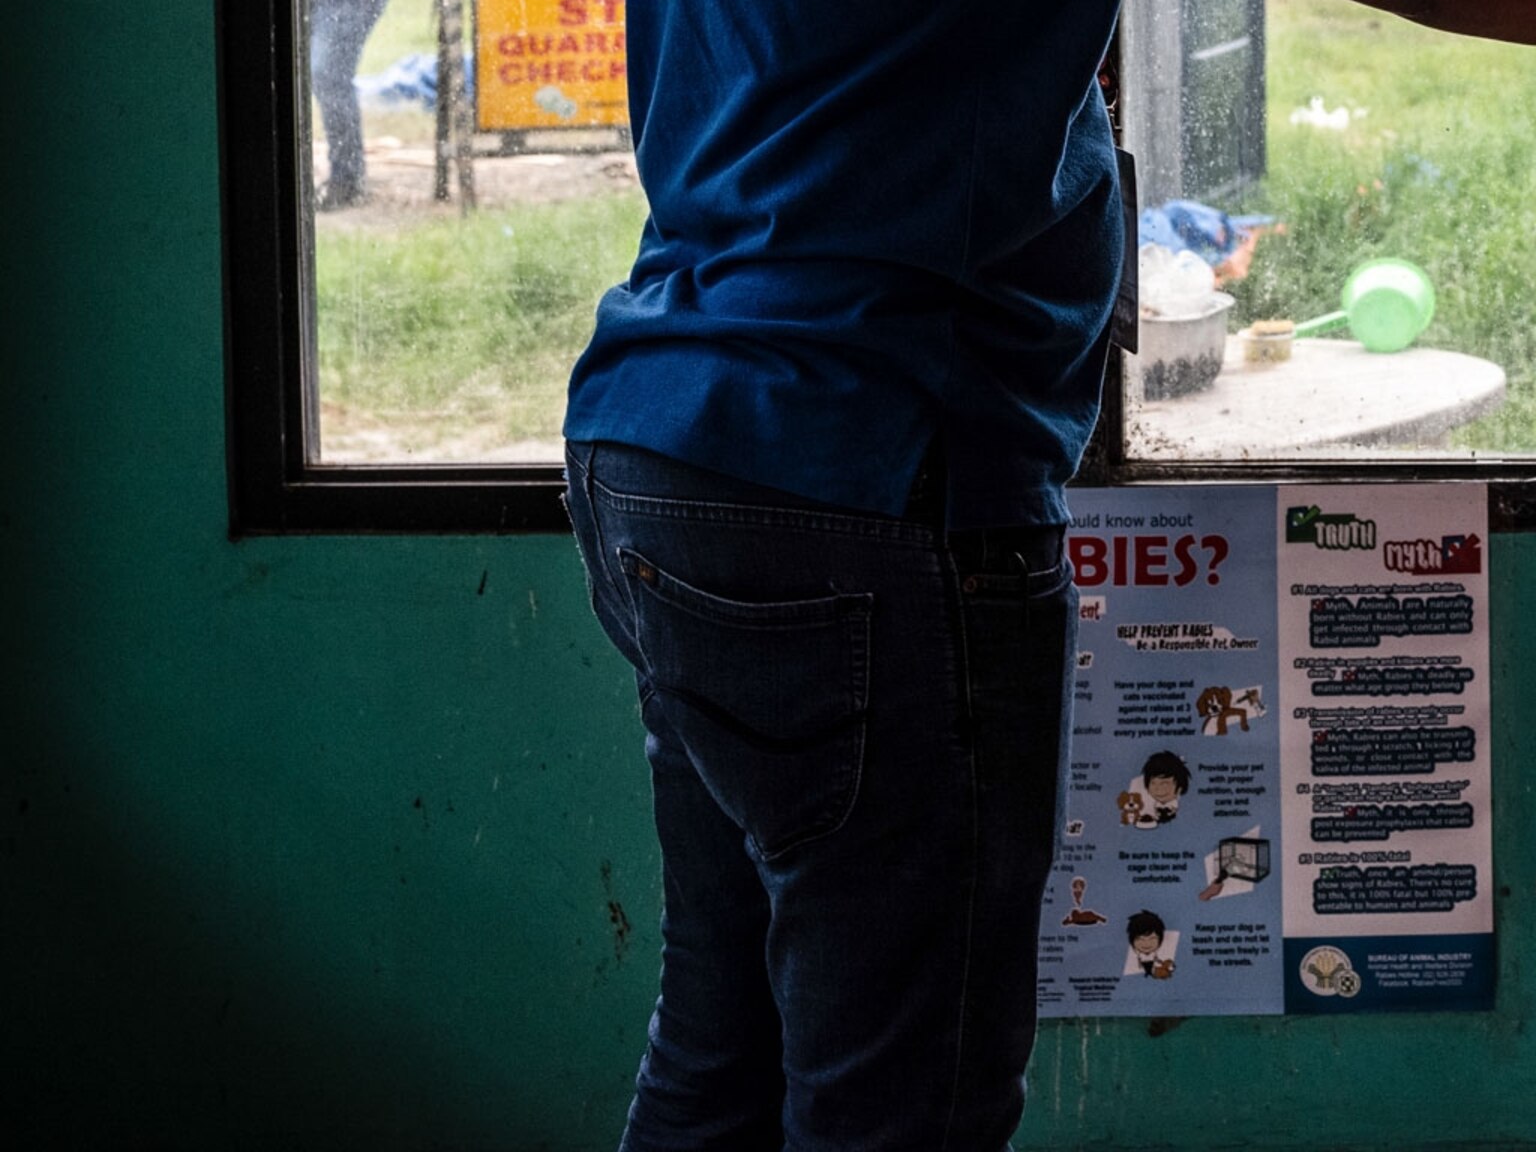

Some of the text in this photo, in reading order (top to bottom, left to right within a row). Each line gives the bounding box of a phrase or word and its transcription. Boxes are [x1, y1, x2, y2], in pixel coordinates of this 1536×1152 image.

[1068, 513, 1193, 527] ould know about
[1315, 521, 1375, 548] TRUTH
[1068, 535, 1229, 586] BIES?
[1314, 613, 1335, 621] born
[1338, 613, 1372, 621] without
[1410, 612, 1426, 620] and
[1450, 611, 1469, 621] only
[1118, 624, 1213, 638] HELP PREVENT RABIES
[1314, 622, 1469, 634] get infected through contact with
[1137, 639, 1257, 650] Be a Responsible Pet Owner
[1115, 680, 1194, 691] Have your dogs and
[1124, 692, 1185, 701] cats vaccinated
[1119, 704, 1147, 713] against
[1150, 704, 1173, 712] rabies
[1176, 704, 1184, 712] at
[1118, 716, 1191, 726] months of age and
[1114, 728, 1195, 738] every year thereafter
[1199, 764, 1264, 773] Provide your pet
[1209, 775, 1253, 785] with proper
[1236, 787, 1265, 795] enough
[1215, 798, 1231, 806] care
[1119, 851, 1129, 859] Be
[1132, 852, 1149, 860] sure
[1162, 851, 1179, 861] keep
[1182, 851, 1194, 859] the
[1128, 863, 1187, 873] cage clean and
[1196, 924, 1216, 933] Keep
[1219, 925, 1235, 933] your
[1238, 924, 1254, 933] dog
[1192, 936, 1213, 944] leash
[1216, 935, 1230, 943] and
[1232, 935, 1242, 943] do
[1245, 935, 1257, 943] not
[1193, 947, 1212, 955] them
[1236, 947, 1259, 956] freely
[1261, 946, 1269, 954] in
[1209, 958, 1221, 966] the
